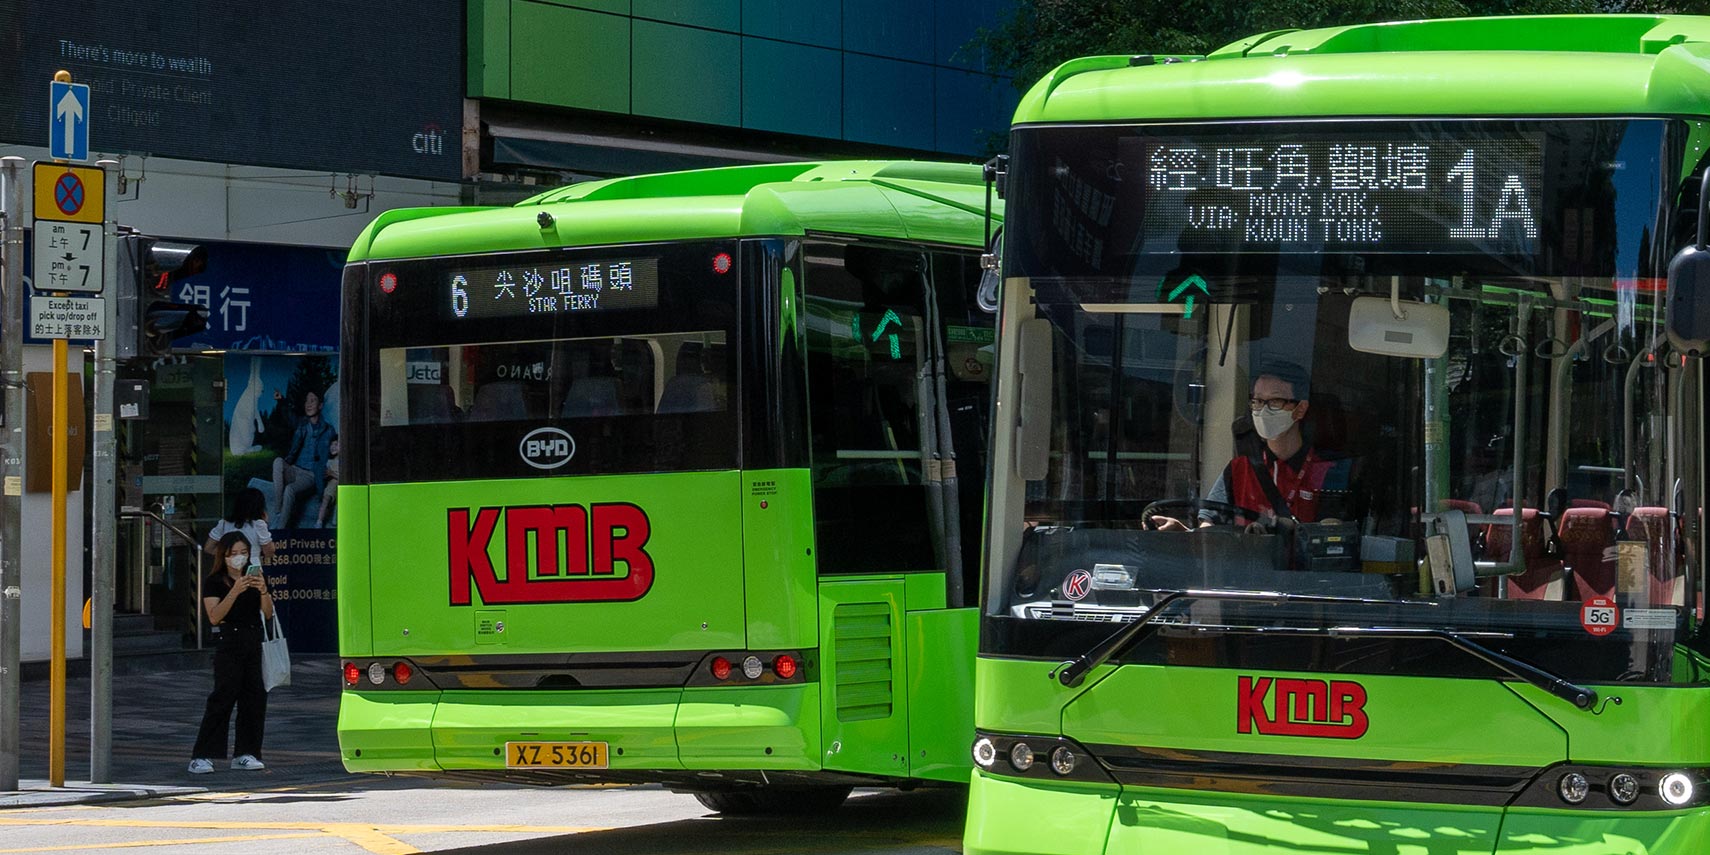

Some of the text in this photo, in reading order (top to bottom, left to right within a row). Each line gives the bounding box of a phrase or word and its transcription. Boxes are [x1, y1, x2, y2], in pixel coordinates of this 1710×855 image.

[59, 39, 212, 74] There's more to wealth
[412, 129, 442, 155] citi
[1447, 148, 1537, 239] 1A
[1188, 205, 1239, 229] VIA:
[1249, 192, 1380, 219] MONG KOK,
[52, 226, 91, 251] am 7
[1245, 218, 1382, 242] KWUN TONG
[48, 236, 69, 249] 上午
[48, 272, 68, 285] 下午
[51, 261, 90, 286] pm 7
[494, 262, 632, 300] 尖沙咀碼頭
[48, 300, 89, 311] Except taxi
[451, 275, 468, 317] 6
[528, 294, 599, 313] STAR FERRY
[39, 311, 97, 322] pick up/drop off
[34, 323, 101, 336] 的士上落客除外
[526, 439, 568, 458] BYD
[290, 538, 326, 549] Private
[448, 502, 655, 607] KMB
[267, 575, 288, 587] igold
[1069, 574, 1090, 596] K
[1590, 609, 1610, 624] 5G
[1237, 675, 1369, 739] KMB
[516, 745, 598, 765] XZ 5361
